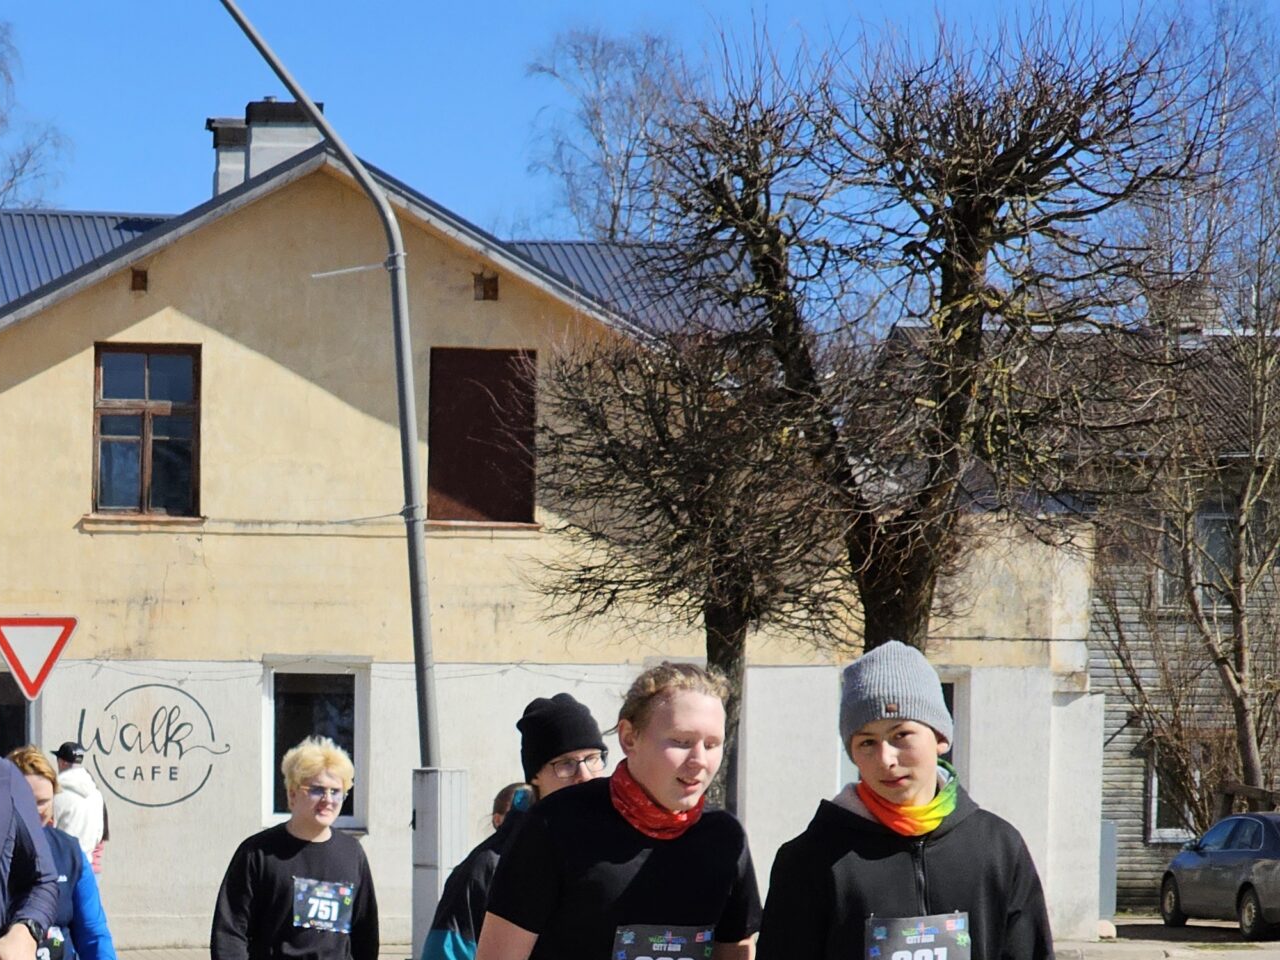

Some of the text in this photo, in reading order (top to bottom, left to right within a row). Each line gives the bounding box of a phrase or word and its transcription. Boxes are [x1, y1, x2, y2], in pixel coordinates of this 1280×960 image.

[78, 705, 231, 760] Walk
[114, 766, 179, 781] CAFE
[307, 897, 339, 921] 751
[652, 943, 667, 951] CITY
